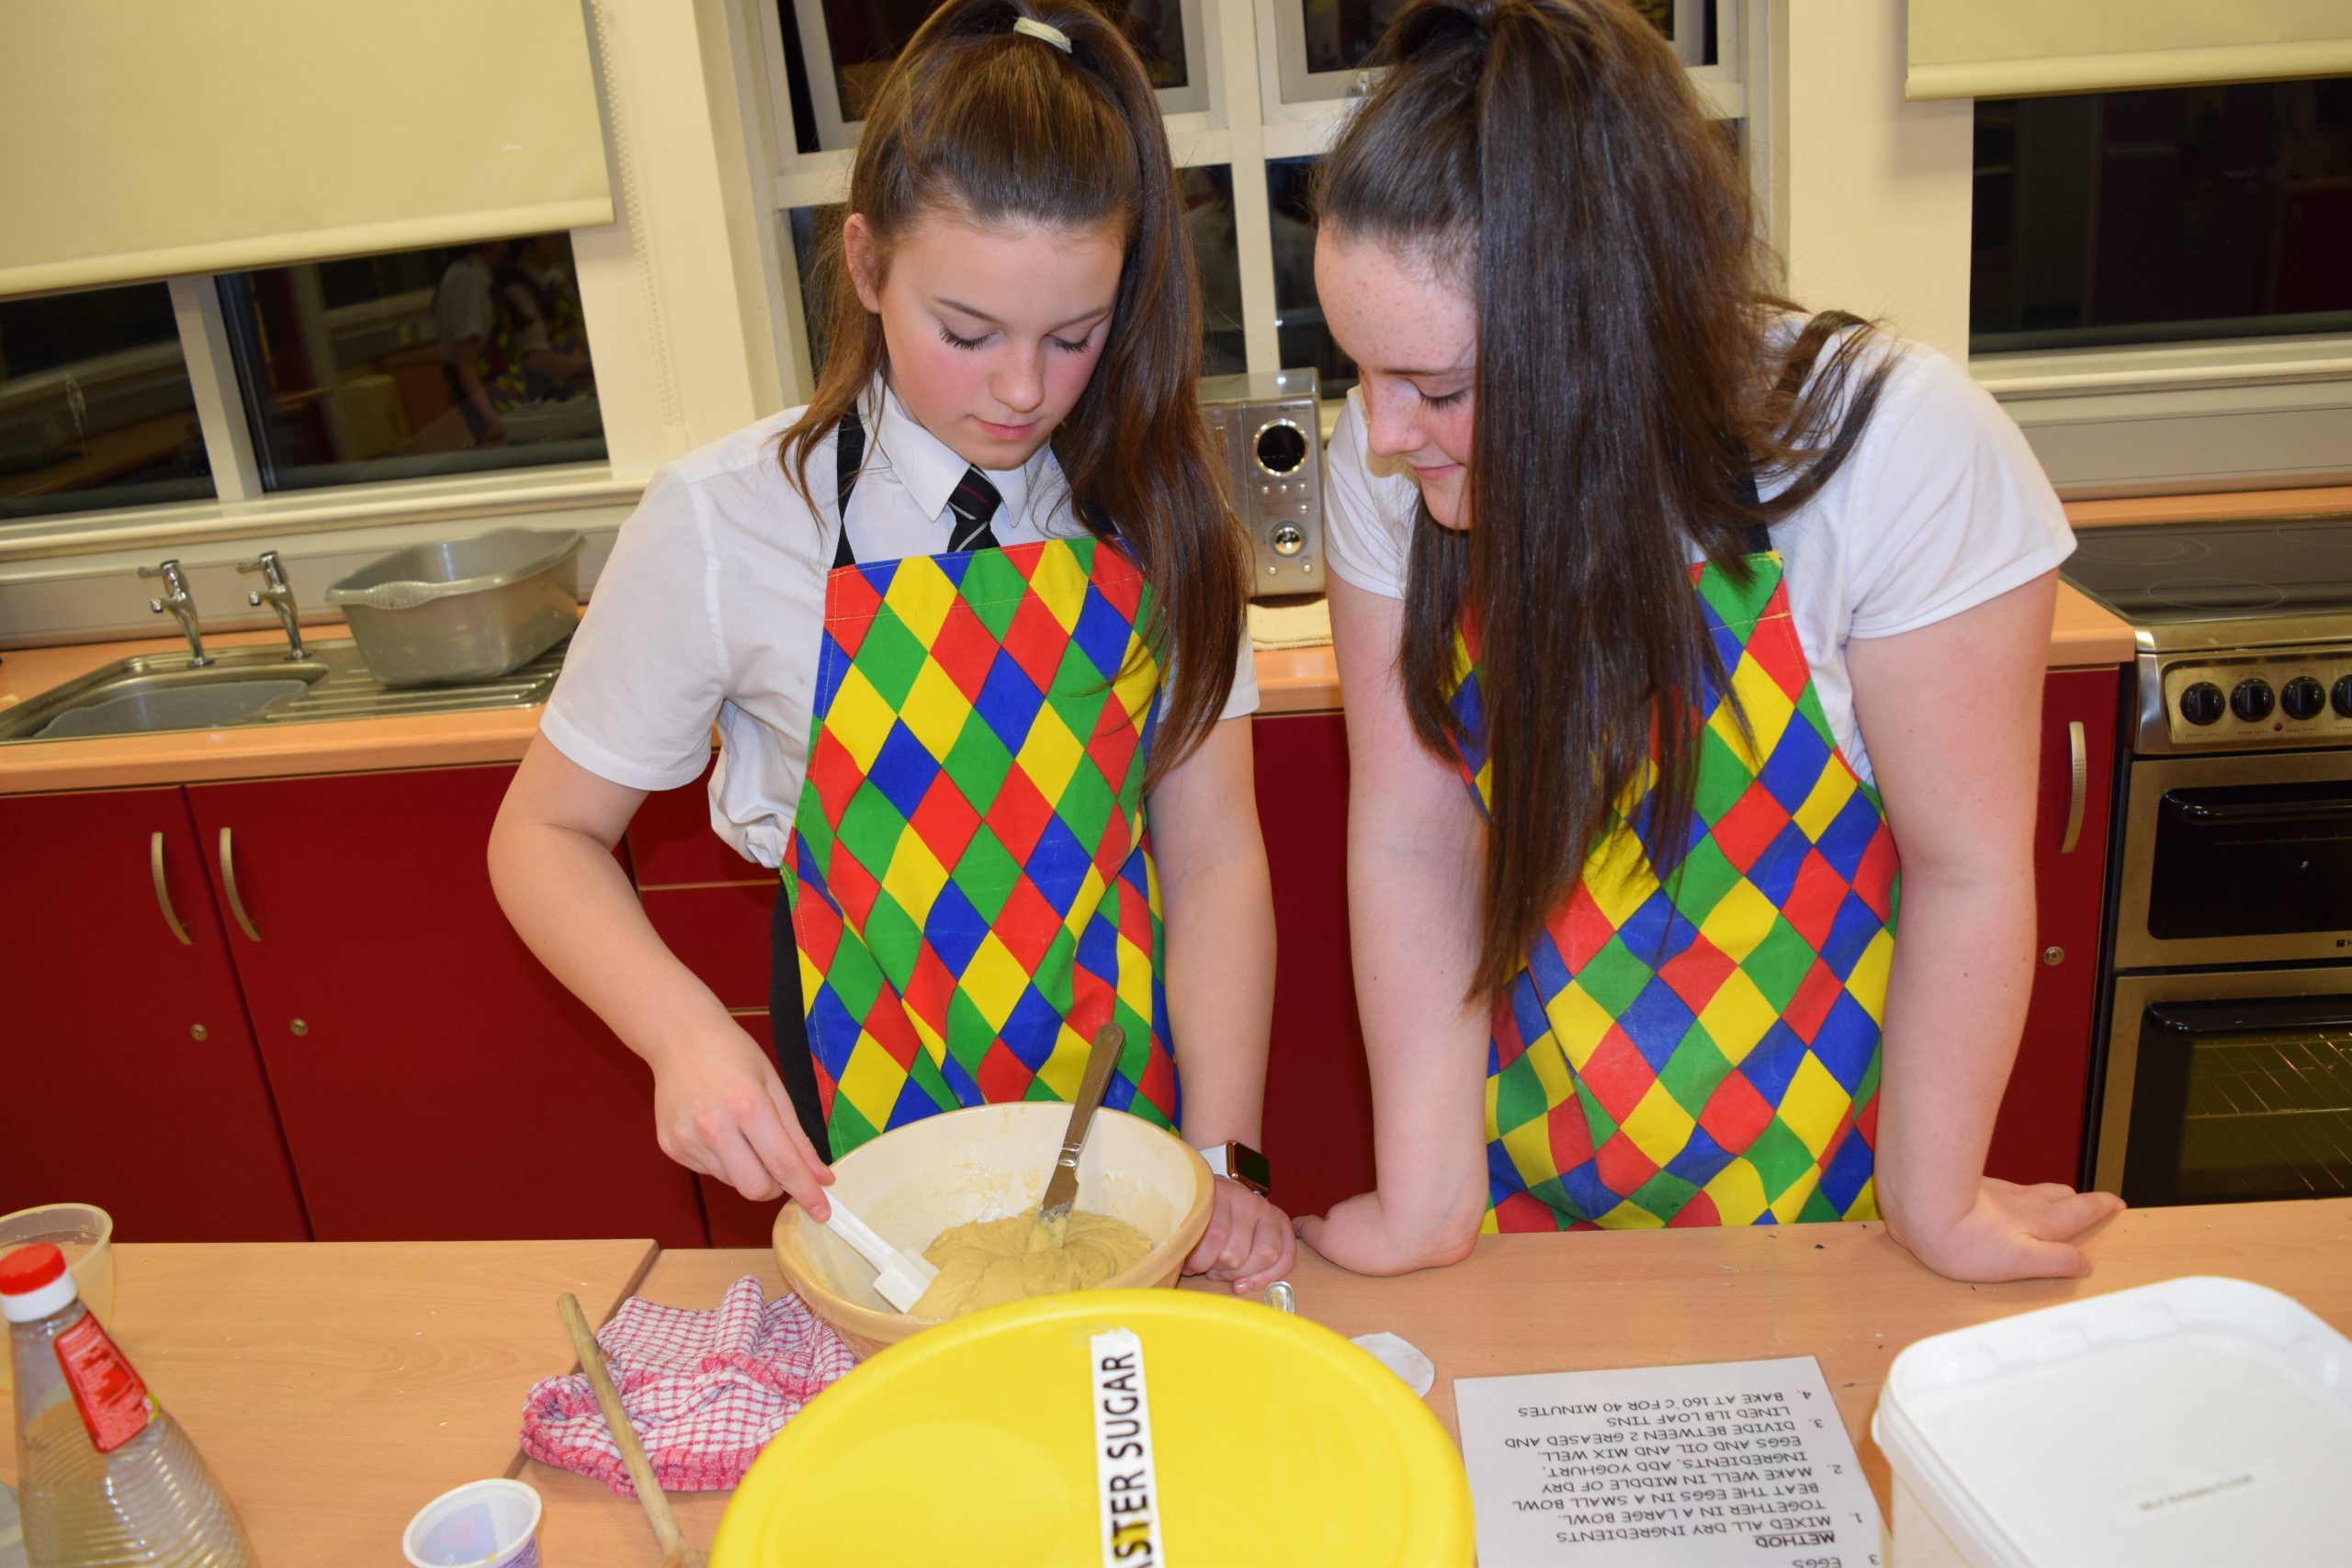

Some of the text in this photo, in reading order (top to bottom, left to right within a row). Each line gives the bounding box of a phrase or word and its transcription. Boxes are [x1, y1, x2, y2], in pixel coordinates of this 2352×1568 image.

[1682, 1397, 1709, 1407] 160
[1714, 1395, 1736, 1405] AT
[1742, 1393, 1784, 1404] BAKE
[1102, 1352, 1143, 1459] SUGAR
[1518, 1404, 1597, 1417] MINUTES
[1603, 1403, 1623, 1413] 40
[1627, 1400, 1660, 1411] FOR
[1606, 1406, 1791, 1427] LINED 1LB LOAF TINS
[1644, 1426, 1727, 1440] BETWEEN
[1732, 1421, 1795, 1435] DIVIDE
[1546, 1432, 1624, 1446] GREASED
[1630, 1432, 1638, 1441] 2
[1756, 1436, 1802, 1449] EGGS
[1505, 1438, 1540, 1449] AND
[1676, 1443, 1708, 1454] OIL
[1713, 1440, 1749, 1451] AND
[1593, 1448, 1628, 1460] MIX
[1634, 1446, 1670, 1457] AND
[1636, 1461, 1671, 1472] ADD
[1682, 1474, 1707, 1485] IN
[1711, 1471, 1759, 1483] WELL
[1764, 1467, 1812, 1481] MAKE
[1542, 1482, 1575, 1494] DRY
[1581, 1481, 1603, 1492] OF
[1610, 1476, 1678, 1491] MIDDLE
[1512, 1483, 1819, 1511] BEAT THE EGGS IN A SMALL BOWL
[1682, 1508, 1693, 1517] A
[1700, 1506, 1724, 1517] IN
[1728, 1499, 1826, 1516] TOGETHER
[1622, 1508, 1678, 1523] LARGE
[1692, 1522, 1726, 1535] DRY
[1731, 1521, 1762, 1532] ALL
[1770, 1516, 1830, 1529] MIXED
[1556, 1526, 1686, 1542] INGREDIENTS
[1754, 1530, 1835, 1548] METHOD
[1792, 1554, 1879, 1568] 3 EGGS
